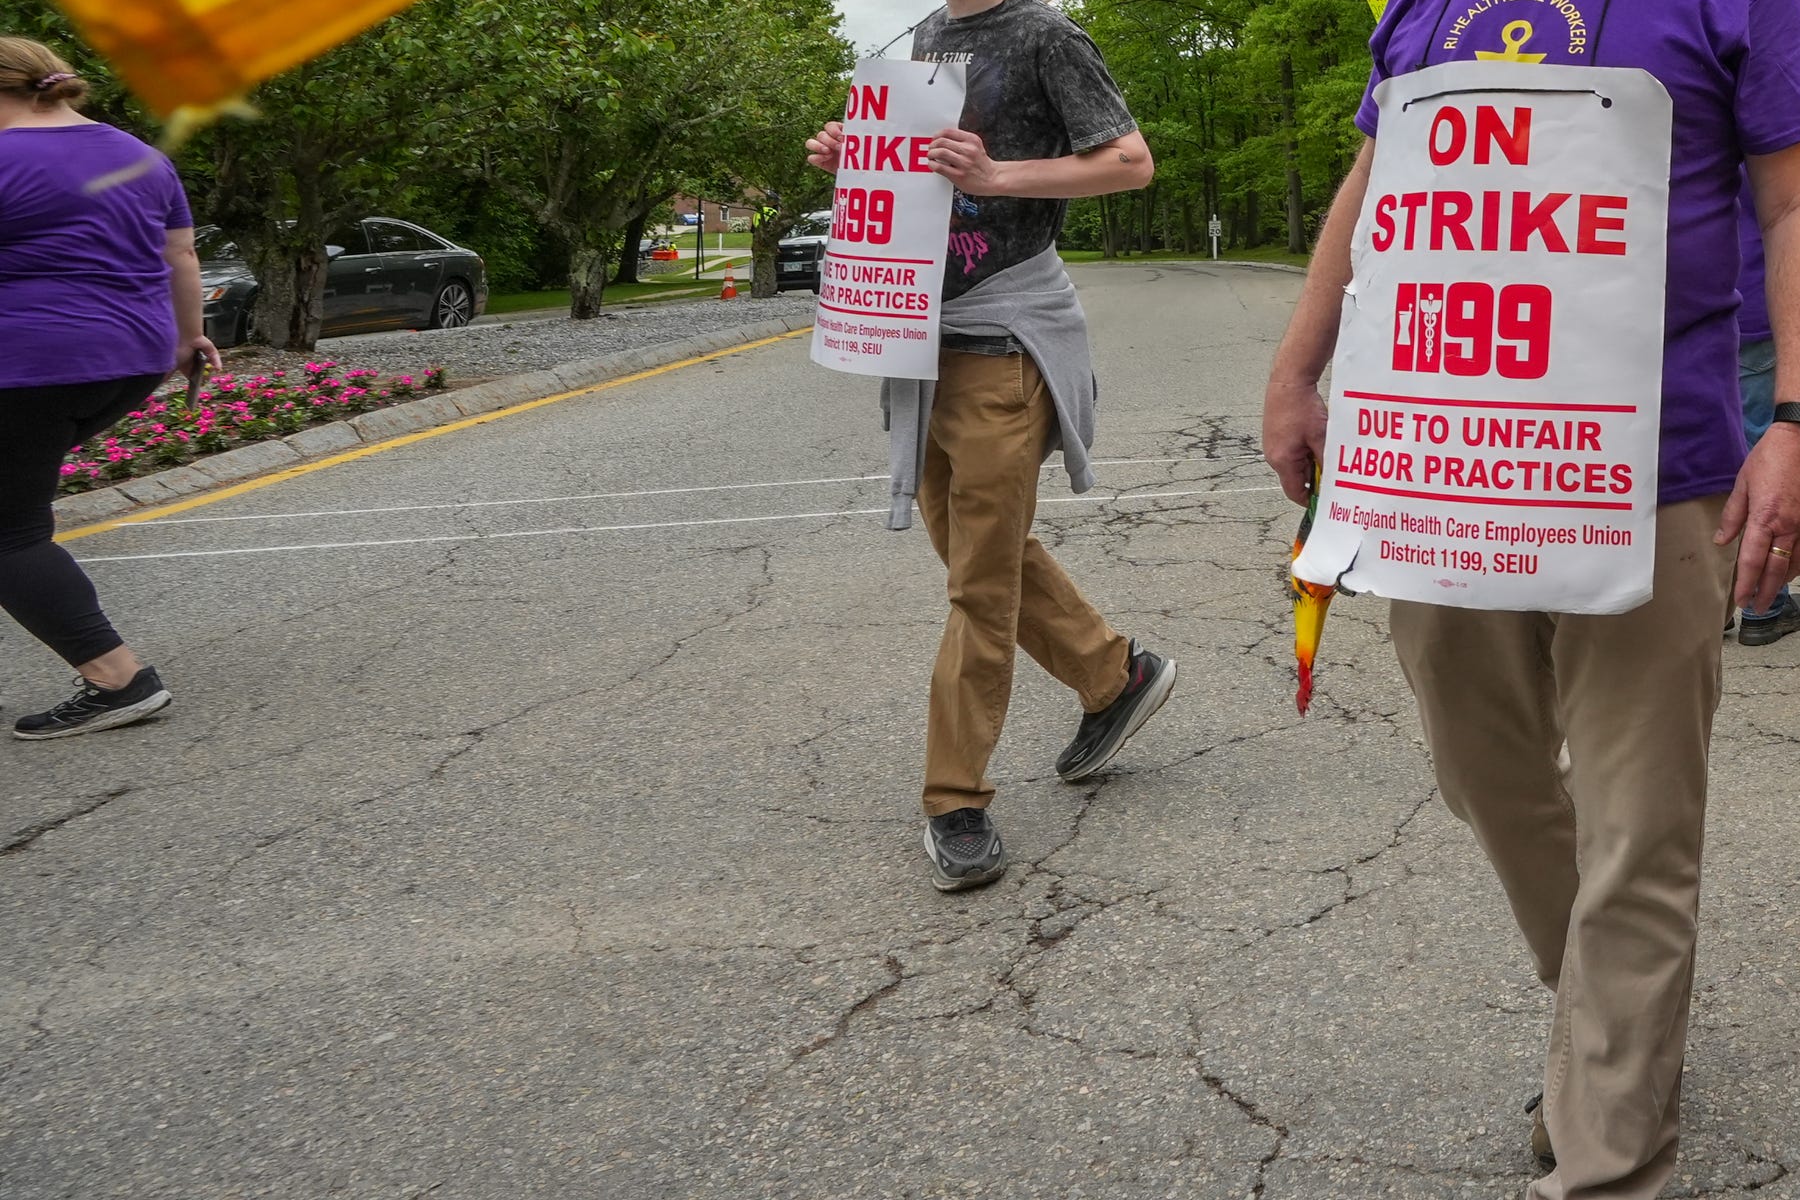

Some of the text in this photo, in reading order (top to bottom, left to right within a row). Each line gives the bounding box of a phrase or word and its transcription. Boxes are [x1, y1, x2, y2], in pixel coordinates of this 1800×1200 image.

[1443, 37, 1459, 49] RI
[847, 85, 889, 121] ON
[841, 134, 935, 173] RIKE
[1428, 105, 1532, 166] ON
[1371, 190, 1628, 256] STRIKE
[835, 263, 848, 281] TO
[852, 265, 916, 287] UNFAIR
[838, 286, 929, 311] PRACTICES
[859, 324, 900, 340] Employees
[903, 328, 927, 341] Union
[862, 343, 882, 355] SEIU
[1392, 281, 1552, 380] 1199
[1358, 408, 1603, 451] DUE TO UNFAIR
[1337, 444, 1634, 495] LABOR PRACTICES
[1329, 501, 1633, 547] New England Health Care Employees Union
[1380, 540, 1539, 576] District 1199, SEIU
